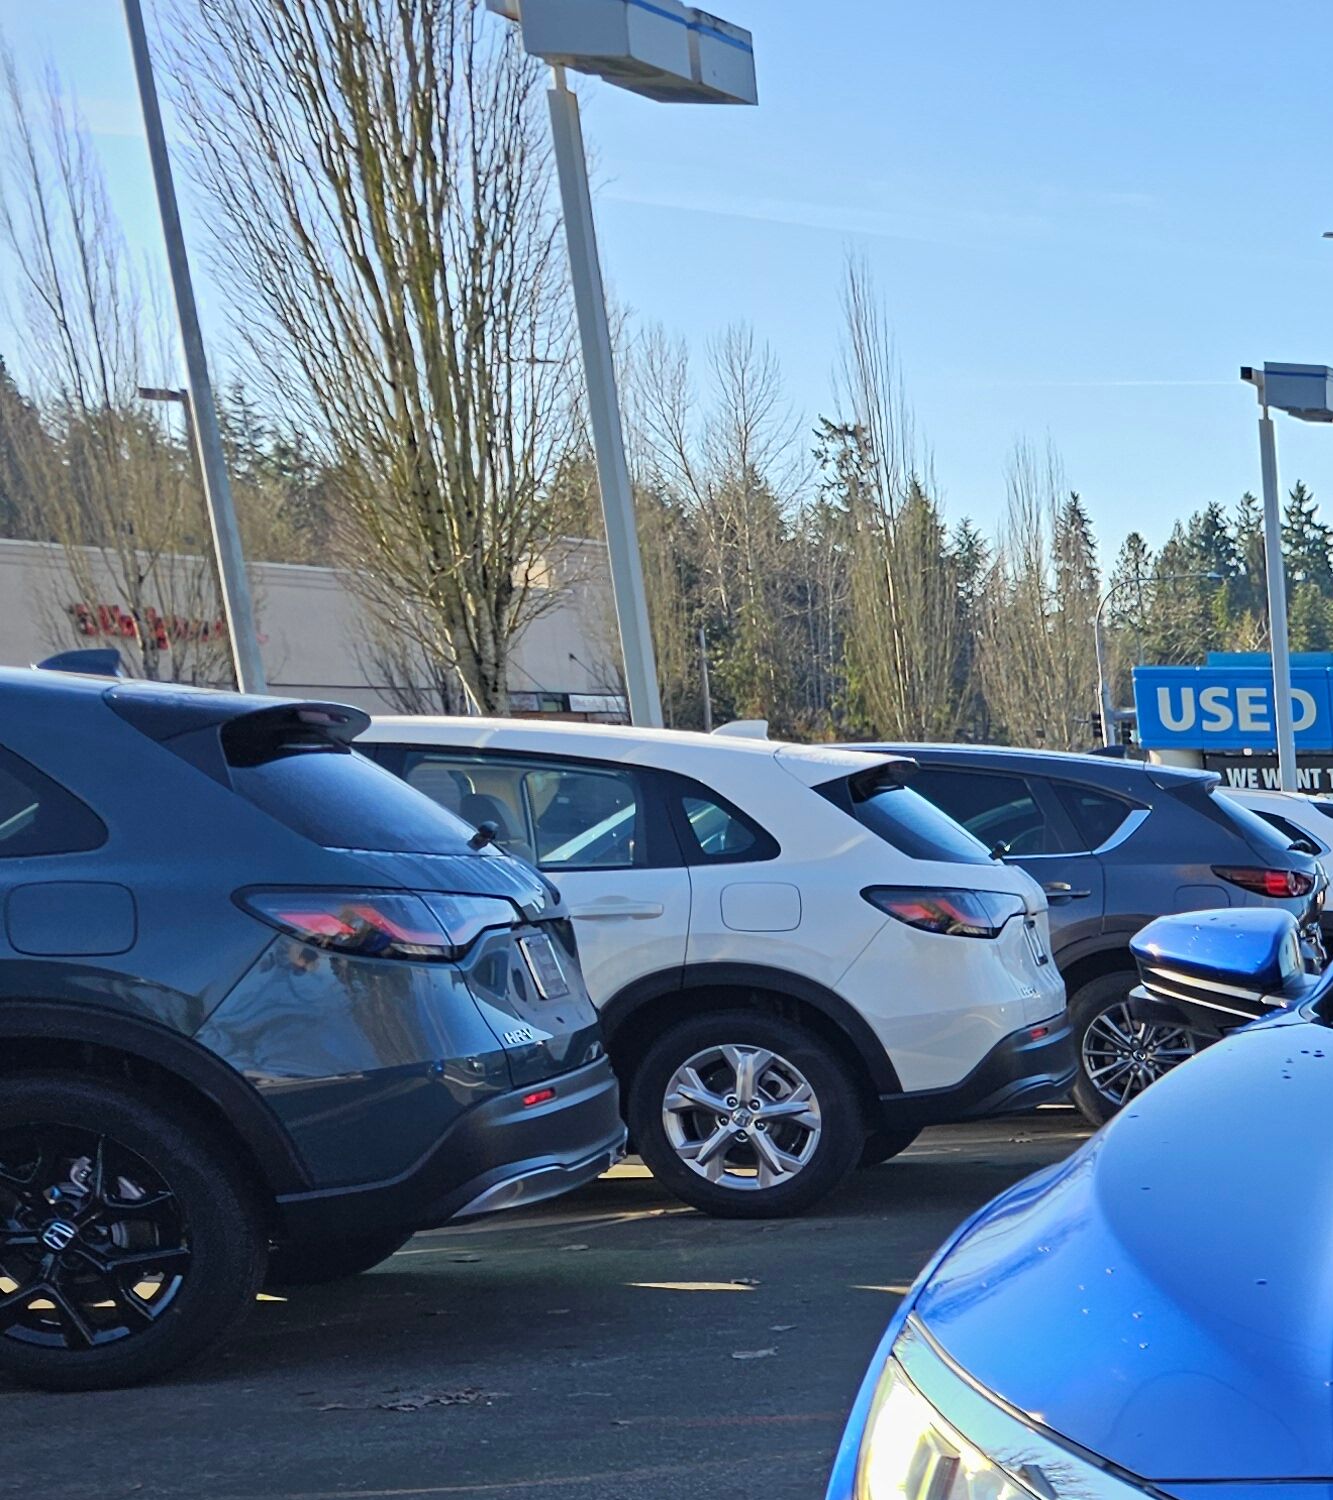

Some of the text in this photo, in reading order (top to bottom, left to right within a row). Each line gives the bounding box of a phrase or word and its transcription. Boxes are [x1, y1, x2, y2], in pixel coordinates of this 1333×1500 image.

[1156, 686, 1317, 732] USED
[1226, 768, 1259, 789] WE
[1262, 768, 1321, 789] WNT
